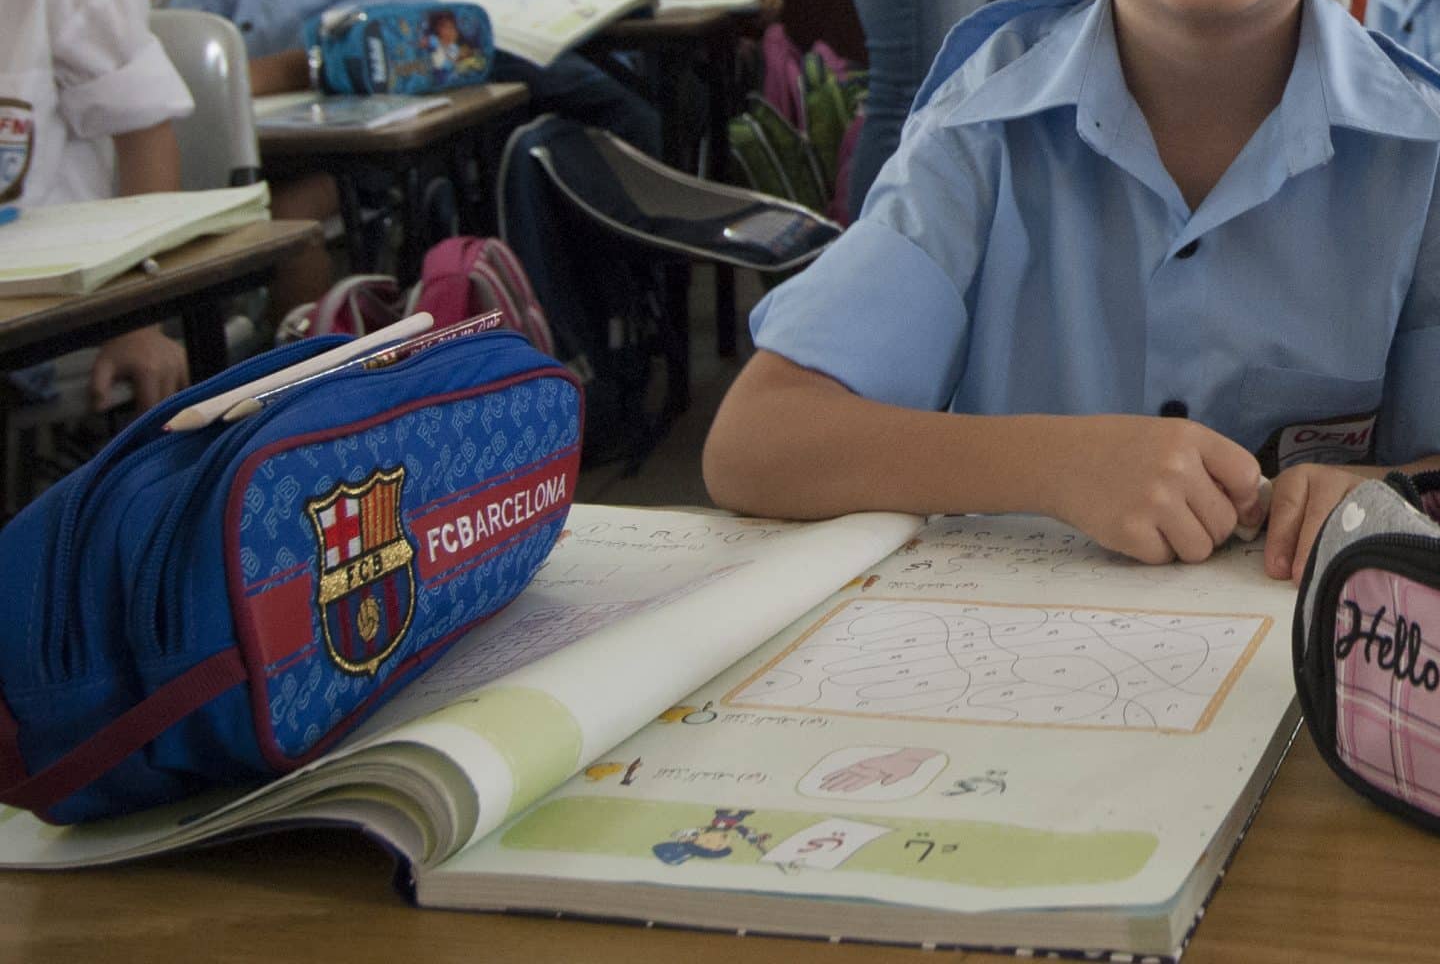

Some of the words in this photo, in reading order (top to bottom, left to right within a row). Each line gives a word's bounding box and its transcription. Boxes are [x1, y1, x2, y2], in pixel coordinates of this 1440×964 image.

[0, 119, 31, 135] FM
[1293, 427, 1371, 447] OFM
[345, 552, 384, 589] FCB
[1334, 599, 1440, 692] Hello
